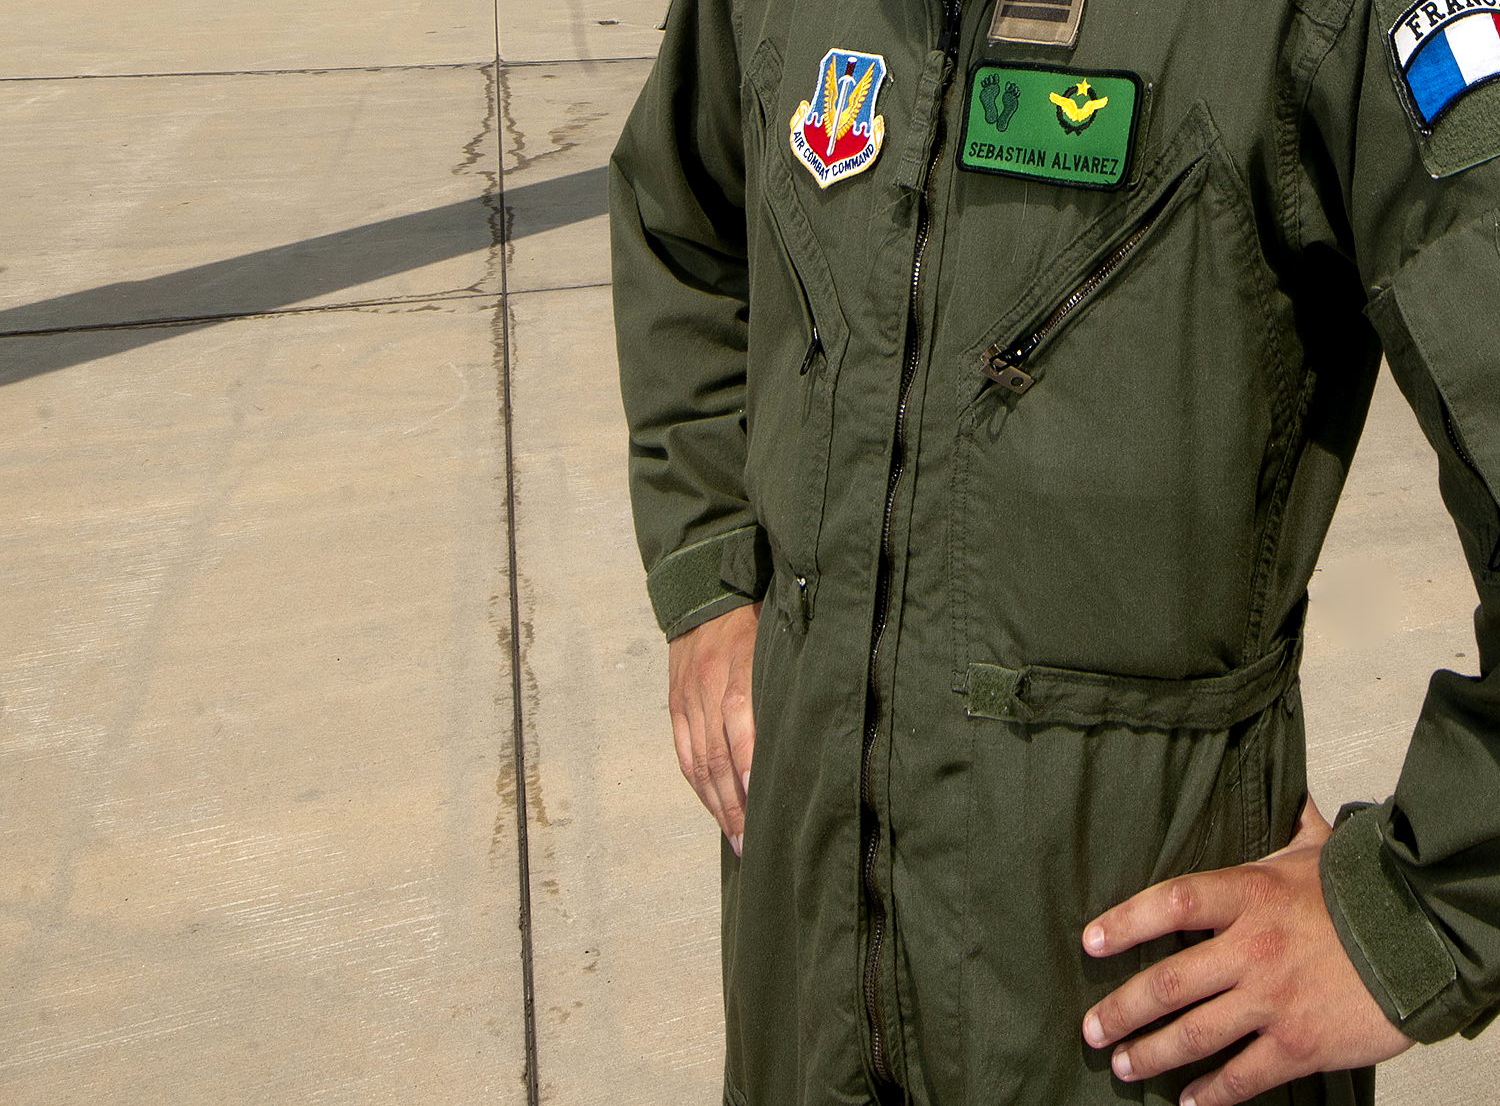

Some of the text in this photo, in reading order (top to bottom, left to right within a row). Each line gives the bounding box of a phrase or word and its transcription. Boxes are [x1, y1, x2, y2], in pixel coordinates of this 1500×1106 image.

[793, 131, 874, 181] AIR COMBAT COMMAND
[968, 141, 1119, 176] SEBASTIAN ALVAREZ
